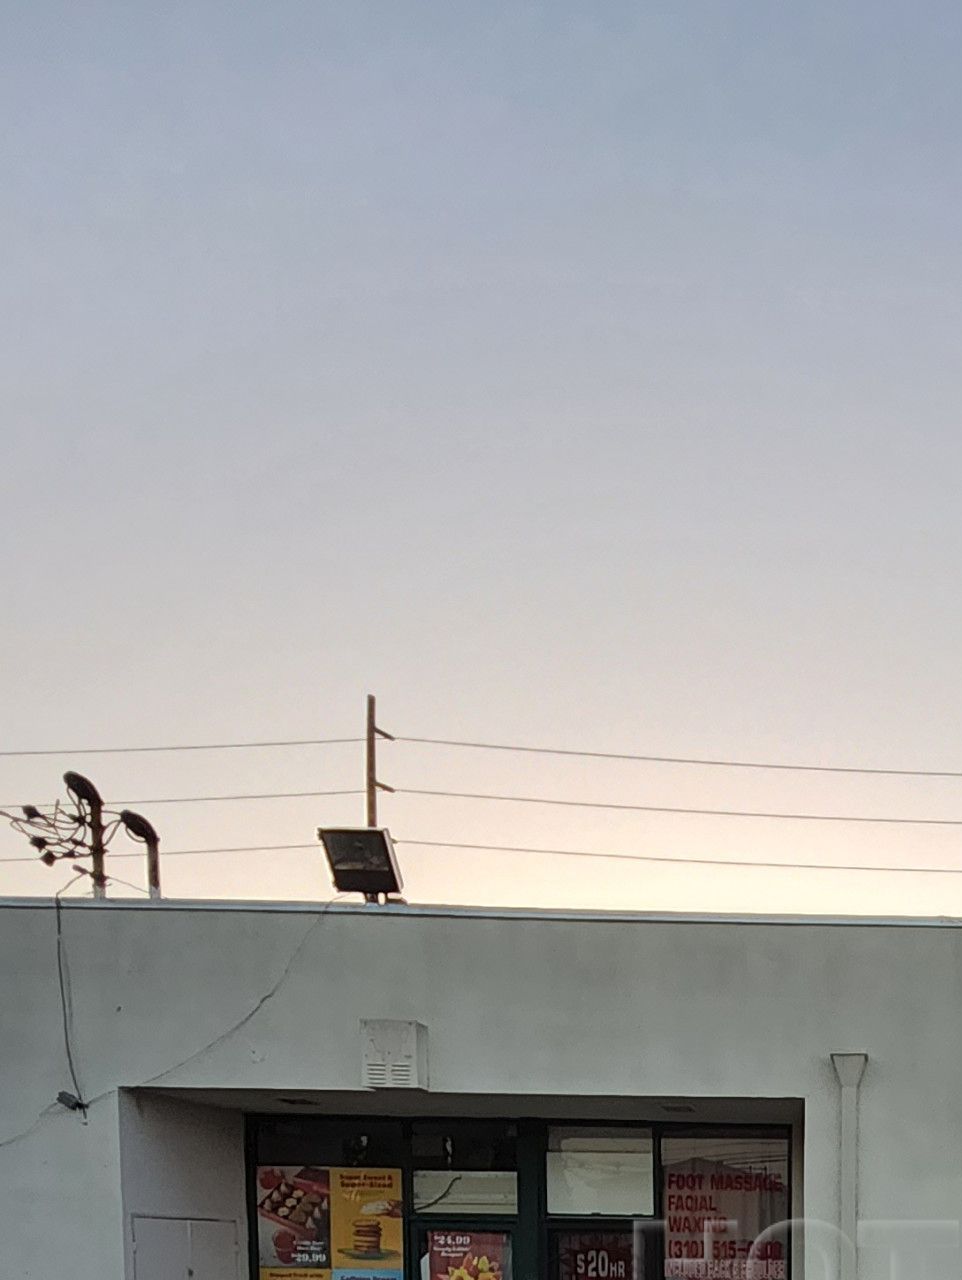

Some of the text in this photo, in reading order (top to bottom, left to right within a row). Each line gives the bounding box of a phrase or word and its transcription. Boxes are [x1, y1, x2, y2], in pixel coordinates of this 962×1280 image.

[668, 1173, 785, 1192] FOOT MASSAGE
[668, 1195, 717, 1212] FACIAL
[669, 1216, 728, 1233] WAXING
[668, 1241, 705, 1258] (310)
